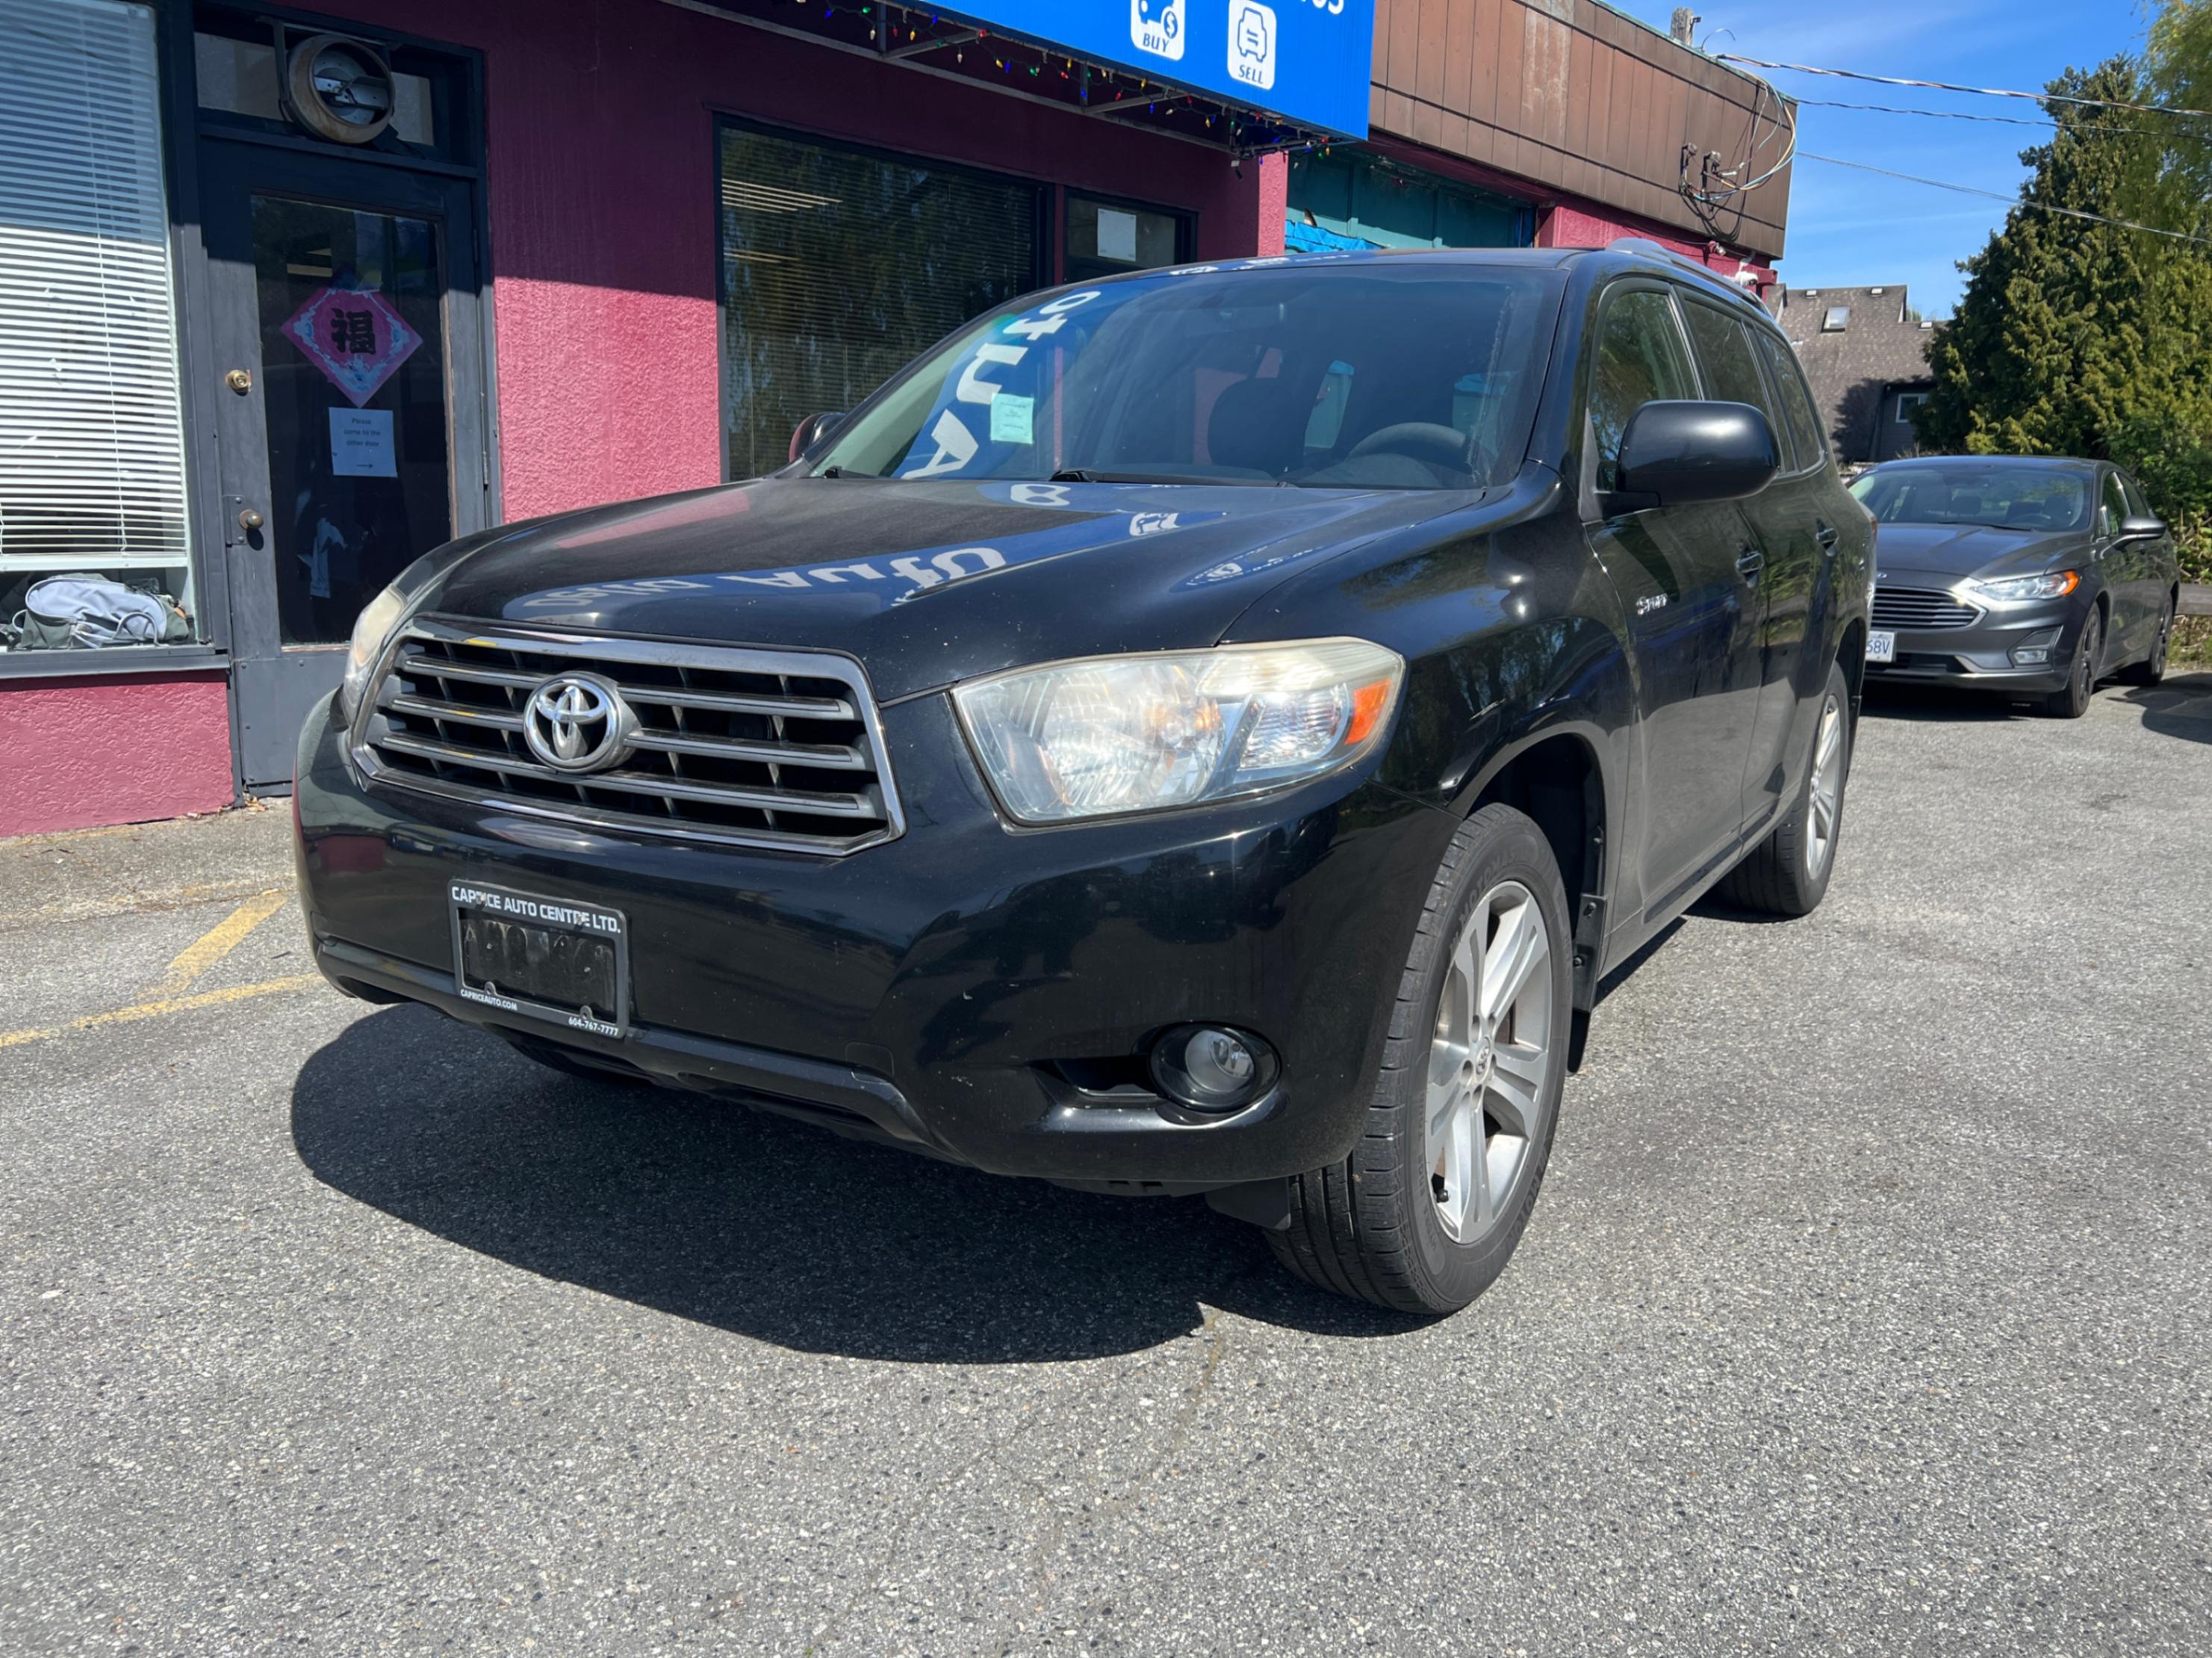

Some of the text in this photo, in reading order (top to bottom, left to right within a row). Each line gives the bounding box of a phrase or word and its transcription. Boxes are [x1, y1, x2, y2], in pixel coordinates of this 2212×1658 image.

[1143, 33, 1169, 53] BUY
[1238, 64, 1264, 84] SELL
[329, 308, 376, 355] 福
[452, 886, 621, 934] CAPCE AUTO CENTRE LTD.
[460, 988, 518, 1011] CAPRICEAUTO.COM
[568, 1016, 619, 1037] 604-767-7777
